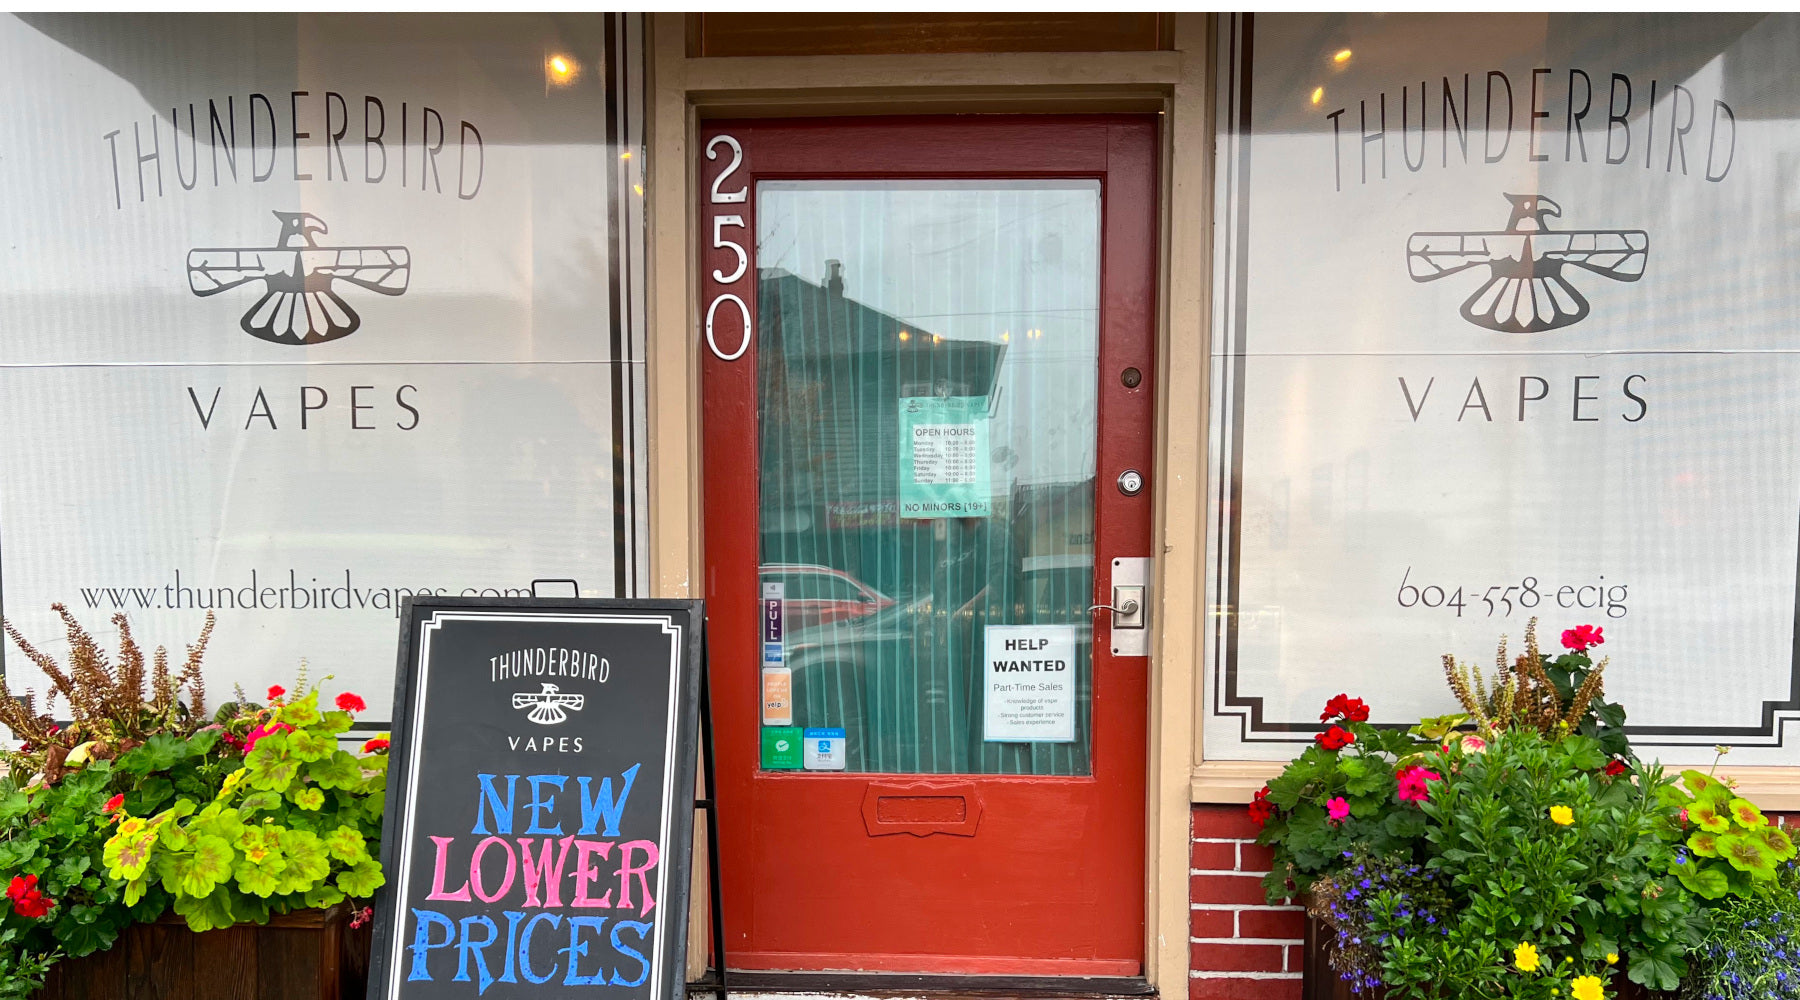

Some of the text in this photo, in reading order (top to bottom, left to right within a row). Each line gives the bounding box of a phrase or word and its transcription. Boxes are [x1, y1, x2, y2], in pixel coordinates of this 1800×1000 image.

[103, 91, 485, 210] THUNDERBIRD
[1326, 68, 1737, 192] THUNDERBIRD
[705, 134, 751, 361] 250
[187, 384, 421, 431] VAPES
[1398, 374, 1648, 423] VAPES
[915, 428, 975, 437] OPEN HOURS
[905, 502, 987, 512] NO MINORS [19+]
[80, 569, 532, 618] www.thunderbirdvape
[1396, 566, 1628, 619] 604-558-ecig
[769, 601, 778, 640] PULL
[490, 647, 610, 684] THUNDERBIRD
[993, 660, 1066, 672] WANTED
[1005, 639, 1049, 651] HELP
[767, 701, 782, 709] yelp
[993, 682, 1063, 692] Part-Time Sales
[507, 736, 583, 753] VAPES
[470, 762, 641, 837] NEW
[424, 834, 660, 919] LOWER
[405, 907, 654, 996] PRICES
